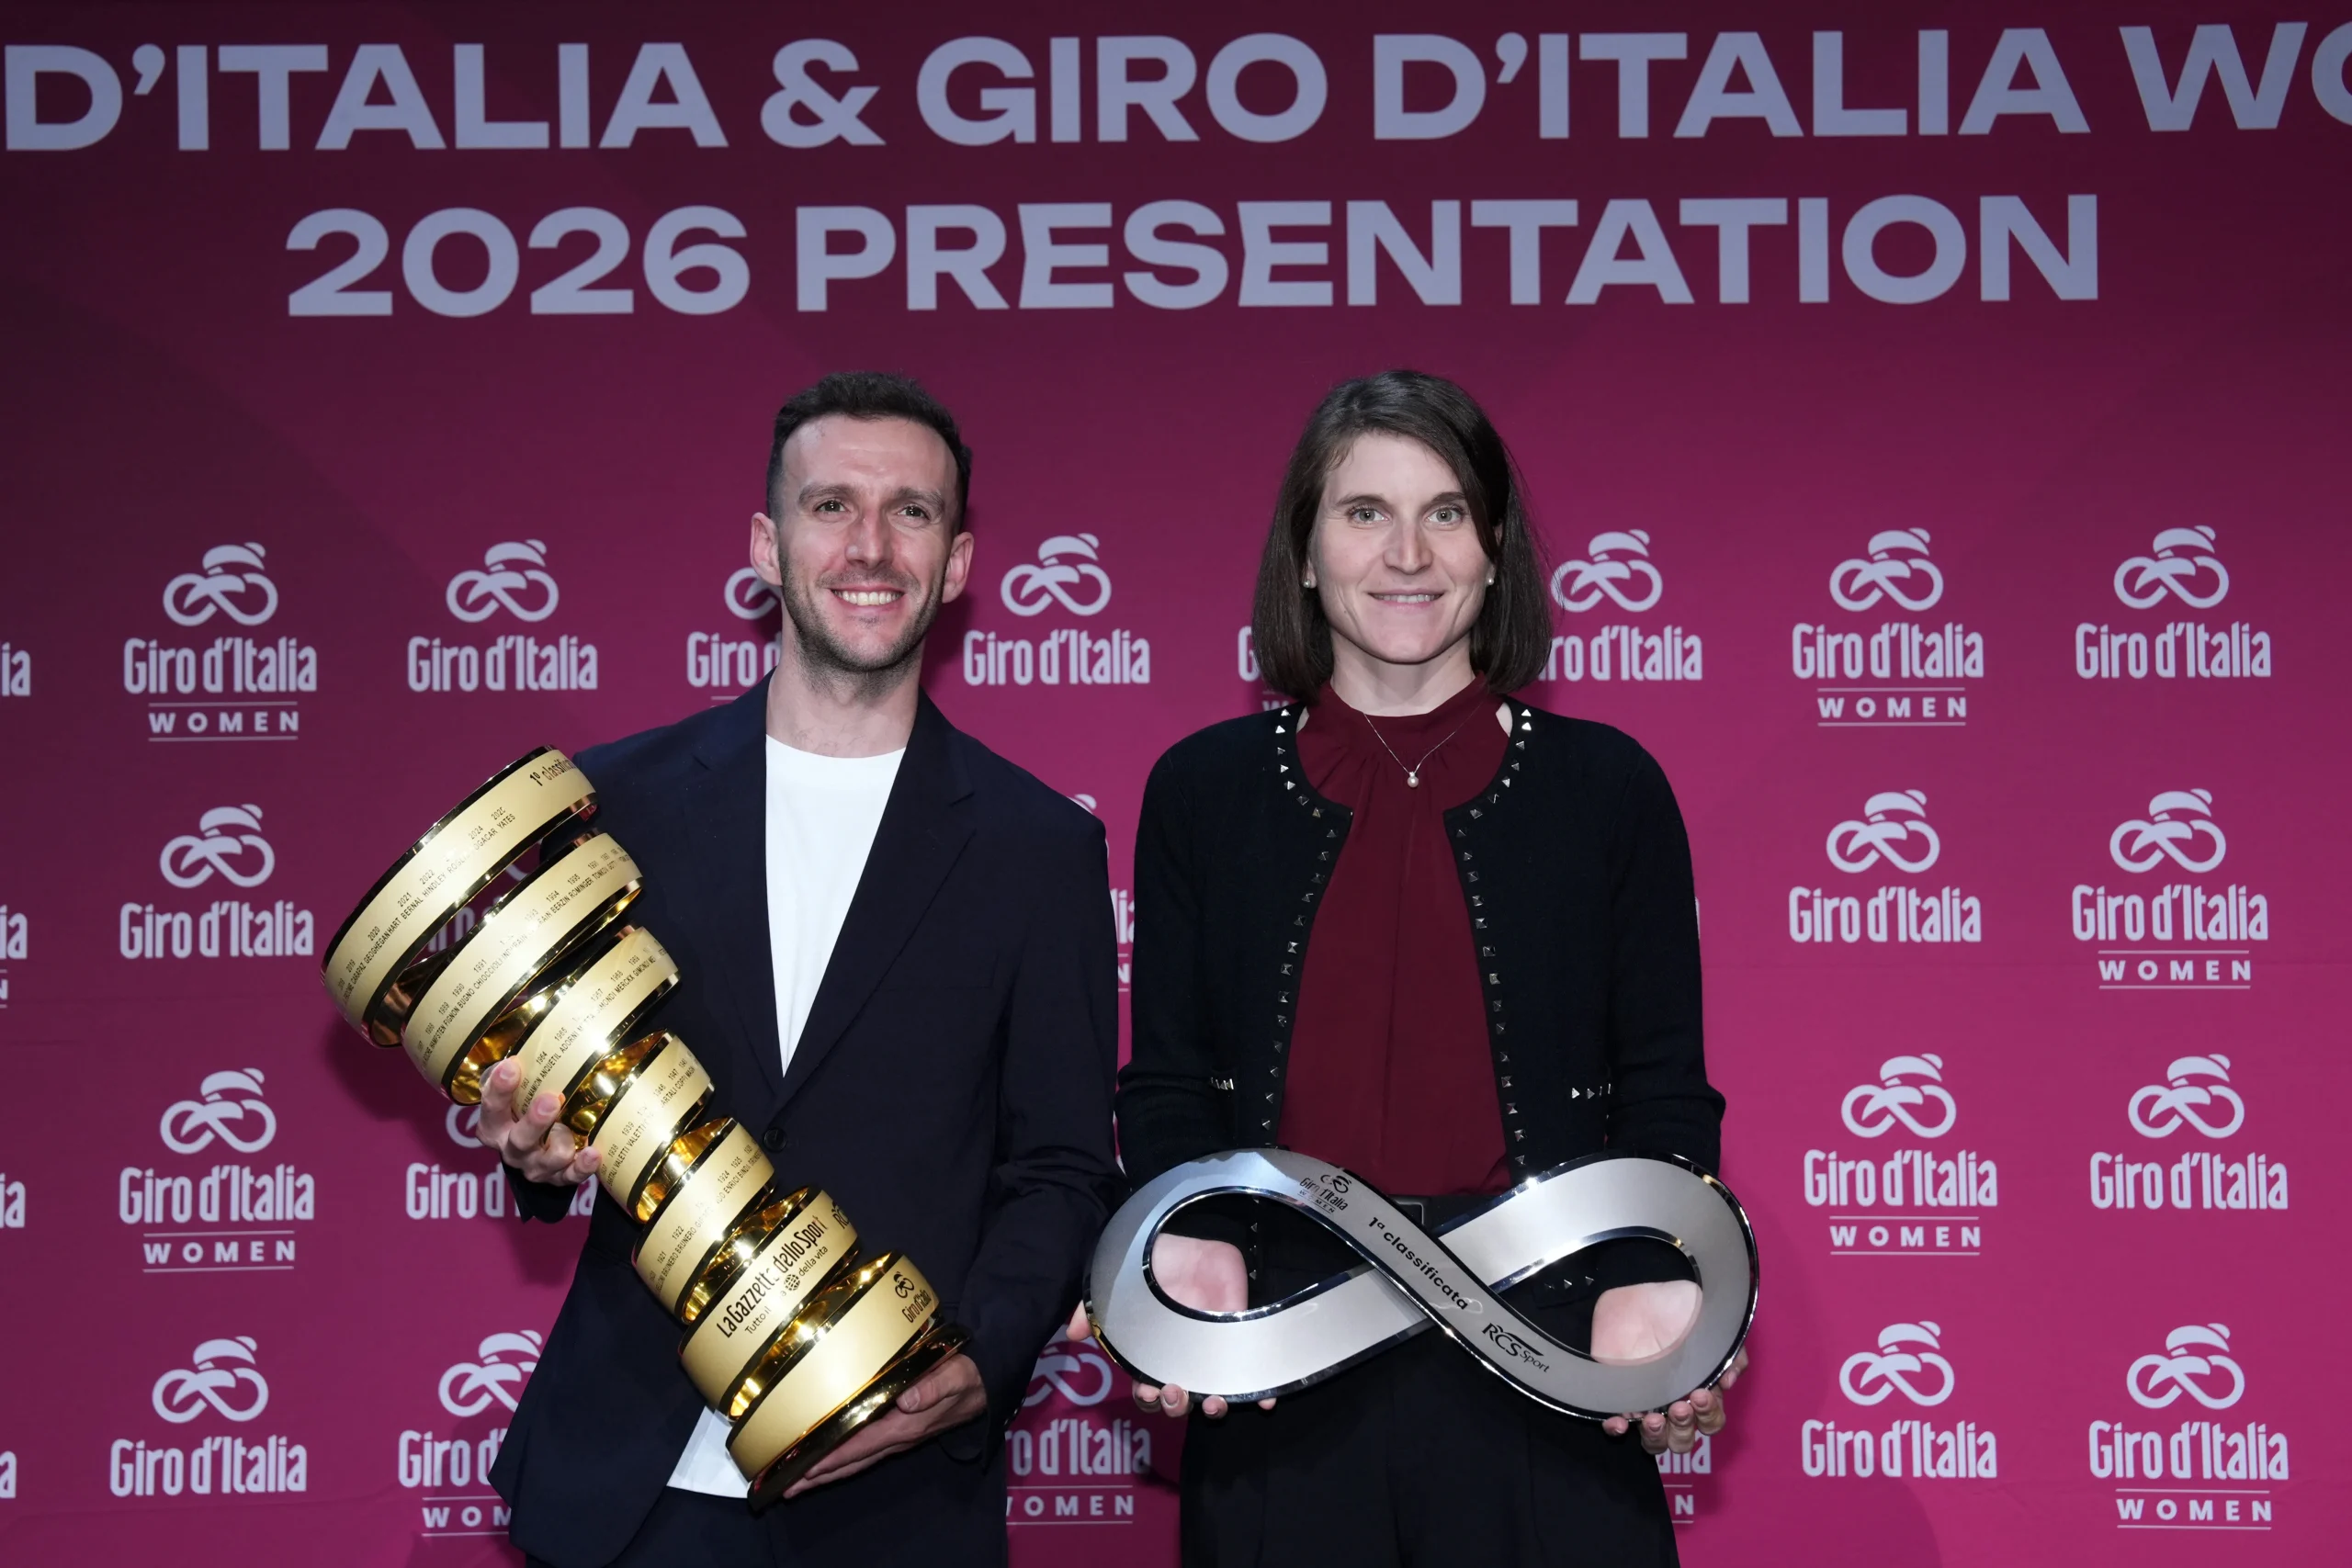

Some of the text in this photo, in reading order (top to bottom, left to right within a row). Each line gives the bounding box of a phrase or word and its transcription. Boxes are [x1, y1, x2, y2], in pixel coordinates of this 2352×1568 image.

[5, 42, 729, 151] D'ITALIA
[760, 39, 886, 149] &
[916, 33, 1328, 146] GIRO
[1373, 28, 2091, 141] D'ITALIA
[286, 194, 2098, 318] 2026 PRESENTATION
[123, 637, 197, 694] Giro
[408, 636, 479, 693] Giro
[686, 630, 758, 688] Giro
[963, 630, 1034, 686] Giro
[1792, 623, 1864, 679] Giro
[2075, 623, 2148, 679] Giro
[148, 711, 299, 734] WOMEN
[1817, 696, 1967, 718] WOMEN
[401, 897, 423, 919] BERNAL
[422, 872, 447, 897] HINDLEY
[473, 828, 497, 850] OGACAR
[496, 812, 514, 829] YATES
[119, 902, 193, 959] Giro
[368, 926, 379, 941] 2020
[397, 892, 412, 907] 2021
[419, 870, 435, 884] 2022
[1789, 886, 1860, 943] Giro
[2072, 884, 2145, 942] Giro
[444, 1006, 459, 1025] FIGNON
[458, 987, 474, 1008] BUGNO
[550, 896, 570, 913] BERZIN
[569, 876, 593, 897] ROMINGER
[473, 959, 486, 973] 1991
[2098, 960, 2251, 981] WOMEN
[539, 1052, 560, 1077] ANQUETIL
[559, 1031, 578, 1052] ADORNI
[614, 974, 634, 993] MERCKX
[614, 1146, 628, 1168] VALETTI
[658, 1087, 677, 1107] ARTALI
[621, 1121, 634, 1135] 1939
[119, 1167, 193, 1224] Giro
[405, 1162, 478, 1220] Giro
[672, 1226, 683, 1239] 1922
[718, 1170, 729, 1183] 1924
[1804, 1149, 1876, 1207] Giro
[2089, 1151, 2164, 1210] Giro
[675, 1226, 695, 1253] BRUNERO
[723, 1175, 740, 1192] ENRICI
[1829, 1225, 1981, 1247] WOMEN
[143, 1240, 296, 1265] WOMEN
[1383, 1230, 1468, 1310] classificata
[745, 1314, 766, 1335] Tutto
[798, 1258, 816, 1277] della
[814, 1246, 828, 1259] vita
[1481, 1323, 1521, 1357] RCS
[1520, 1349, 1551, 1373] Sport
[109, 1438, 185, 1497] Giro
[398, 1429, 471, 1488] Giro
[1802, 1419, 1874, 1478] Giro
[2088, 1420, 2164, 1480] Giro
[422, 1506, 512, 1529] WOM
[2116, 1498, 2272, 1522] WOMEN
